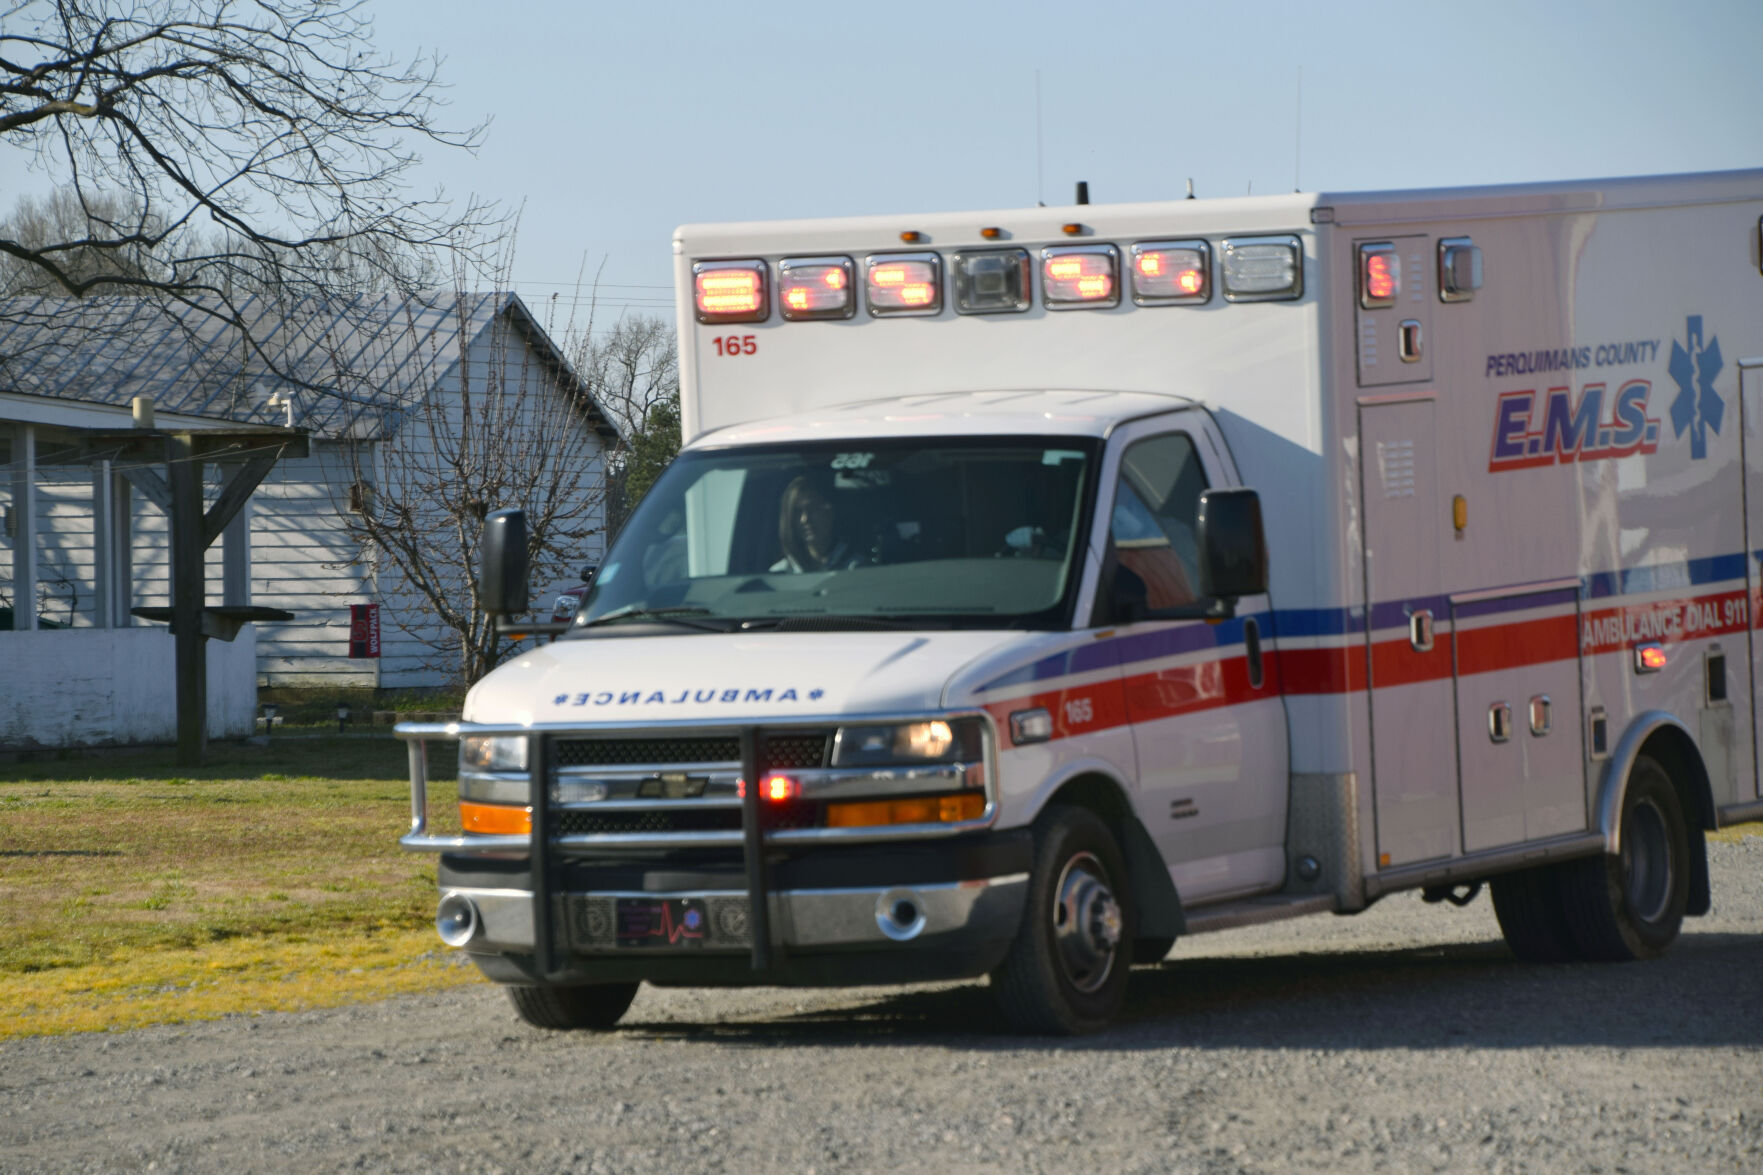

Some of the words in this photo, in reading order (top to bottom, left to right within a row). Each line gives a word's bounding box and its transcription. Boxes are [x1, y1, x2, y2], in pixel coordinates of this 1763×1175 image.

[712, 335, 757, 357] 165
[1486, 347, 1591, 378] PERQUIMANS
[1595, 340, 1661, 367] COUNTY
[1489, 379, 1661, 473] E.M.S.
[1583, 606, 1682, 647] AMBULANCE
[1685, 602, 1723, 632] DIAL
[1724, 598, 1748, 626] 911
[1065, 698, 1093, 723] 165
